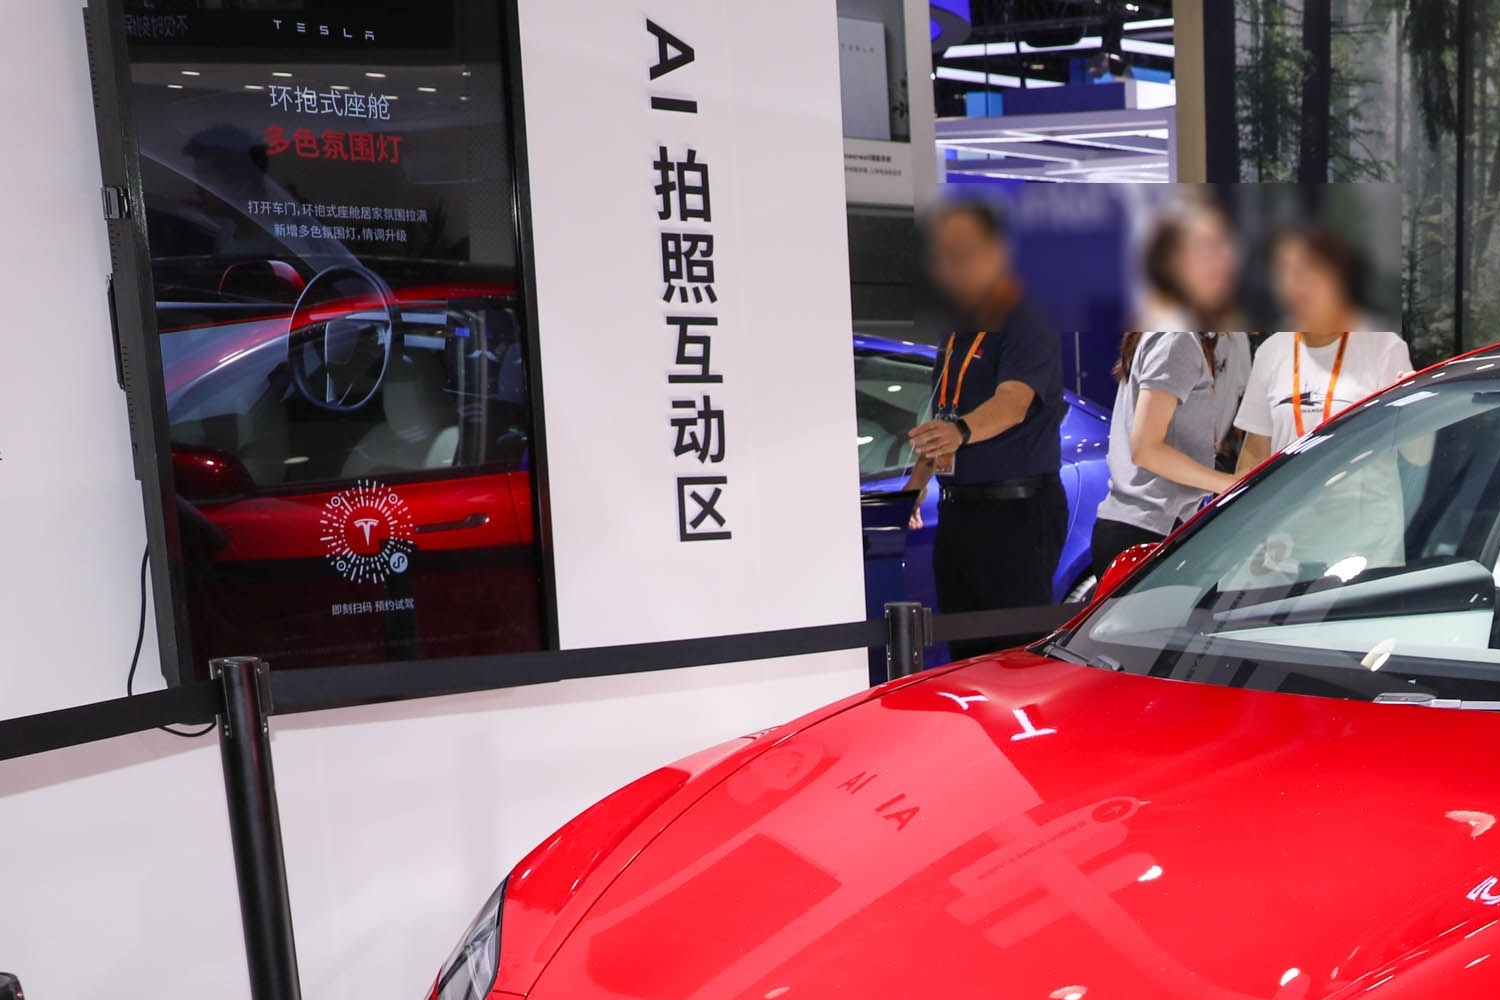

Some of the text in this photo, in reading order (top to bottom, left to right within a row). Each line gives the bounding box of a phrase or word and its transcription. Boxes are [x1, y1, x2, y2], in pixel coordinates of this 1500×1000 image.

[273, 19, 375, 41] TESLA
[267, 84, 391, 121] 环抱式座舱
[263, 124, 403, 164] 多色氛围灯
[646, 18, 733, 543] AI 拍照互动区
